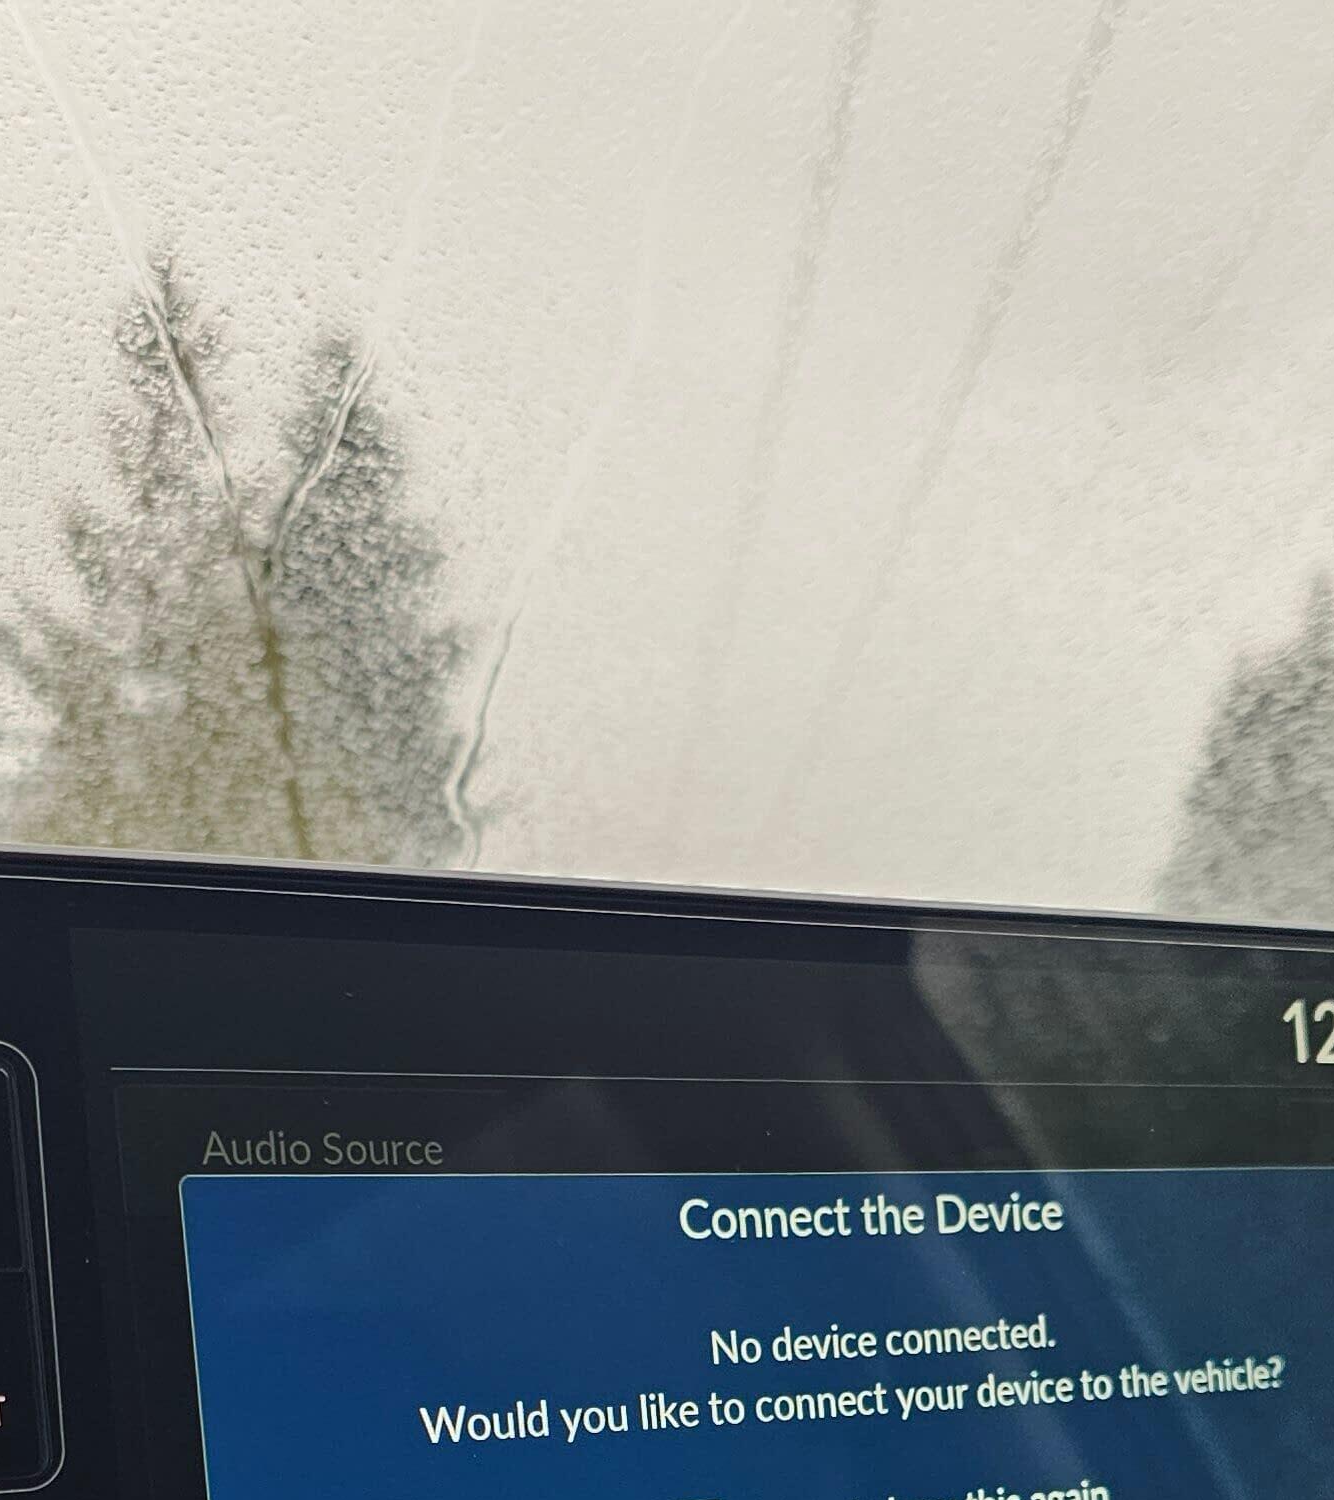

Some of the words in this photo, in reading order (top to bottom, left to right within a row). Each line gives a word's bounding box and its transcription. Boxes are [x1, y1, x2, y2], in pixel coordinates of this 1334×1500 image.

[202, 1130, 311, 1166] Audio
[323, 1132, 443, 1166] Source
[679, 1198, 852, 1240] Connect
[859, 1194, 925, 1236] the
[935, 1191, 1064, 1234] Device
[710, 1329, 762, 1365] No
[772, 1323, 877, 1362] device
[885, 1313, 1056, 1356] connected.
[419, 1399, 550, 1444] Would
[559, 1405, 629, 1443] you
[639, 1392, 700, 1430] like
[707, 1392, 745, 1426] to
[755, 1384, 889, 1423] connect
[894, 1384, 969, 1421] your
[976, 1370, 1074, 1408] device
[1079, 1369, 1113, 1401] to
[1118, 1364, 1169, 1399] the
[1173, 1355, 1284, 1395] vehicle?
